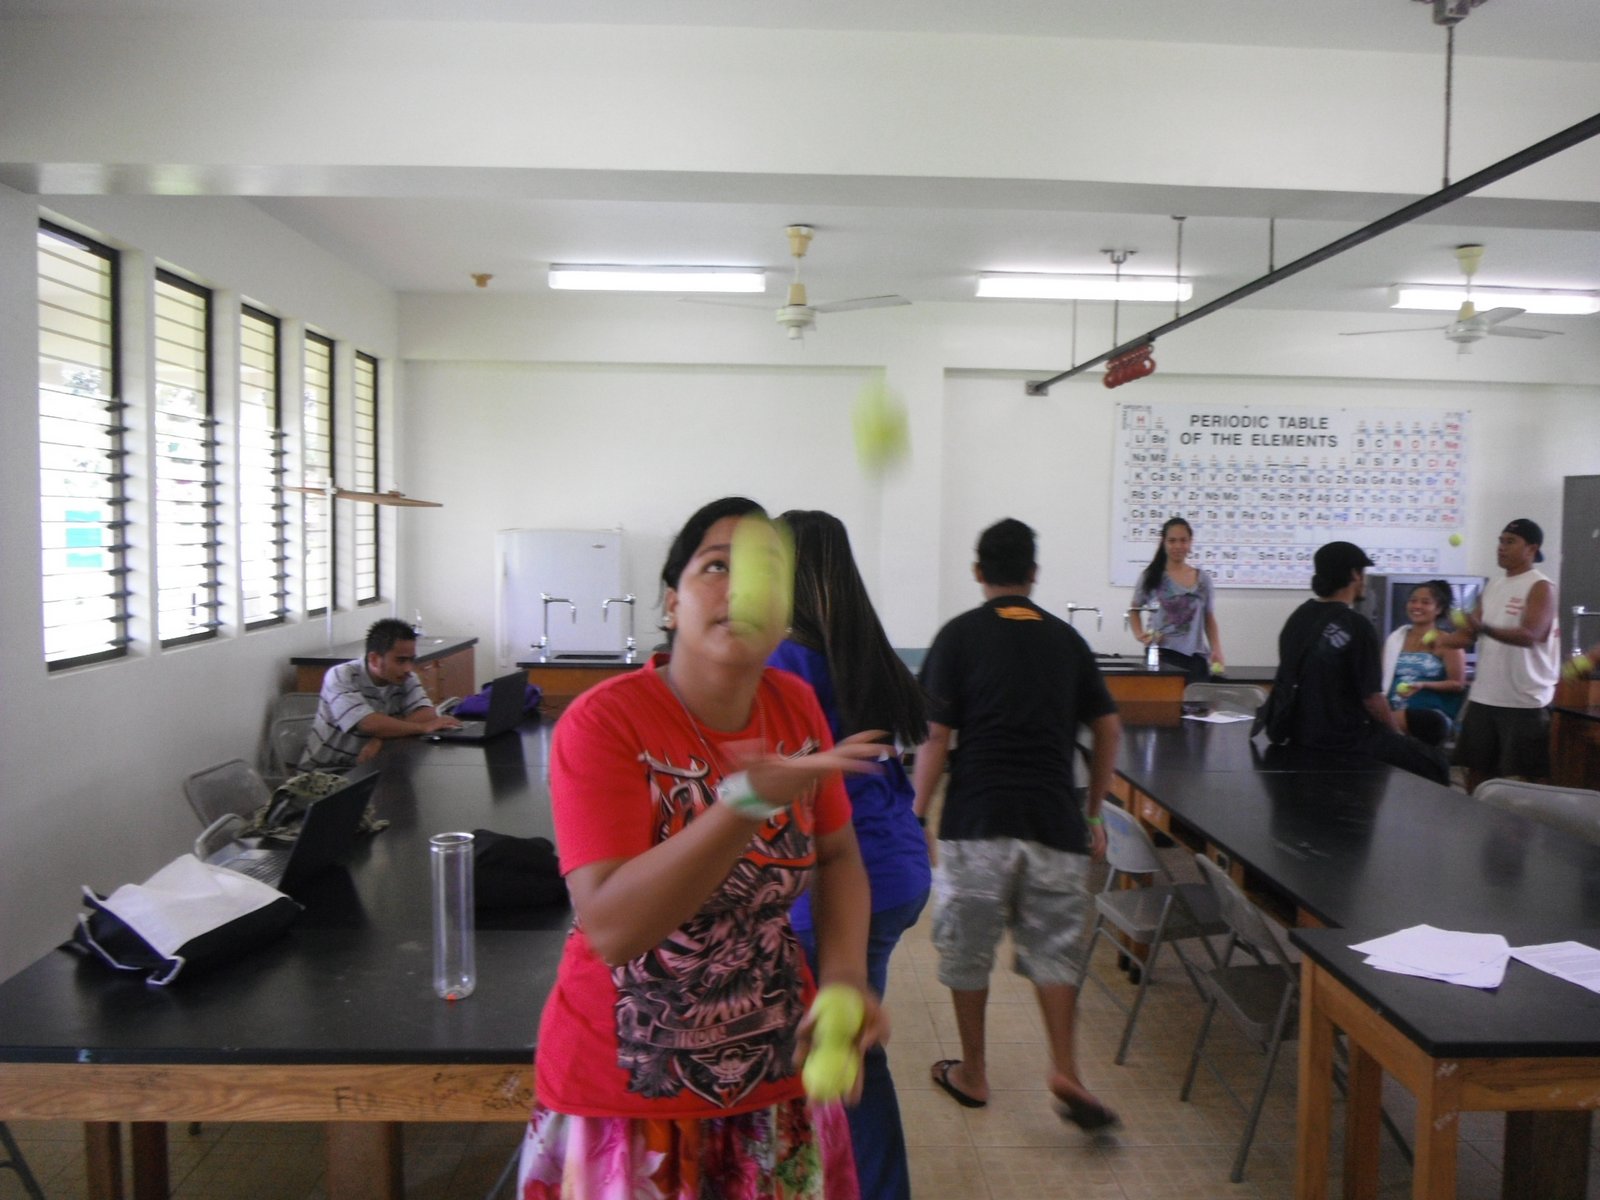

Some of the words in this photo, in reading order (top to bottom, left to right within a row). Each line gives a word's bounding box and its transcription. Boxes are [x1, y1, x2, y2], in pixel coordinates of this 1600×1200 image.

[1136, 416, 1145, 424] H
[1190, 415, 1269, 428] PERIODIC
[1278, 416, 1329, 430] TABLE
[1152, 435, 1166, 444] Be
[1180, 432, 1202, 445] OF
[1210, 433, 1243, 446] THE
[1251, 434, 1338, 448] ELEMENTS
[1357, 439, 1365, 448] B
[1375, 439, 1383, 448] C
[1394, 440, 1402, 448] N
[1411, 440, 1420, 449] O
[1430, 440, 1438, 449] F
[1132, 453, 1147, 462] Na
[1151, 454, 1167, 463] Mg
[1393, 458, 1400, 467] P
[1411, 458, 1418, 467] S
[1135, 472, 1143, 481] K
[1151, 472, 1165, 481] Ca
[1170, 473, 1183, 481] Sc
[1190, 473, 1200, 481] Ti
[1209, 473, 1217, 481] V
[1226, 473, 1238, 482] Cr
[1262, 474, 1274, 483] Fe
[1280, 475, 1294, 483] Co
[1317, 475, 1331, 484] Cu
[1336, 475, 1349, 484] Zn
[1408, 477, 1420, 486] Se
[1132, 491, 1146, 500] Rb
[1152, 491, 1163, 500] Sr
[1172, 492, 1179, 500] Y
[1188, 492, 1199, 500] Zr
[1205, 492, 1219, 500] Nb
[1223, 492, 1239, 501] Mo
[1298, 493, 1311, 502] Pd
[1335, 494, 1349, 502] Cd
[1132, 510, 1145, 518] Cs
[1150, 510, 1163, 518] Ba
[1207, 511, 1218, 519] Ta
[1242, 511, 1255, 520] Re
[1260, 511, 1274, 520] Os
[1299, 512, 1310, 520] Pt
[1132, 528, 1143, 536] Fr
[1206, 551, 1217, 560] Pr
[1223, 552, 1238, 560] Nd
[1259, 552, 1274, 560] Sm
[1278, 552, 1291, 561] Eu
[1296, 553, 1310, 561] Gd
